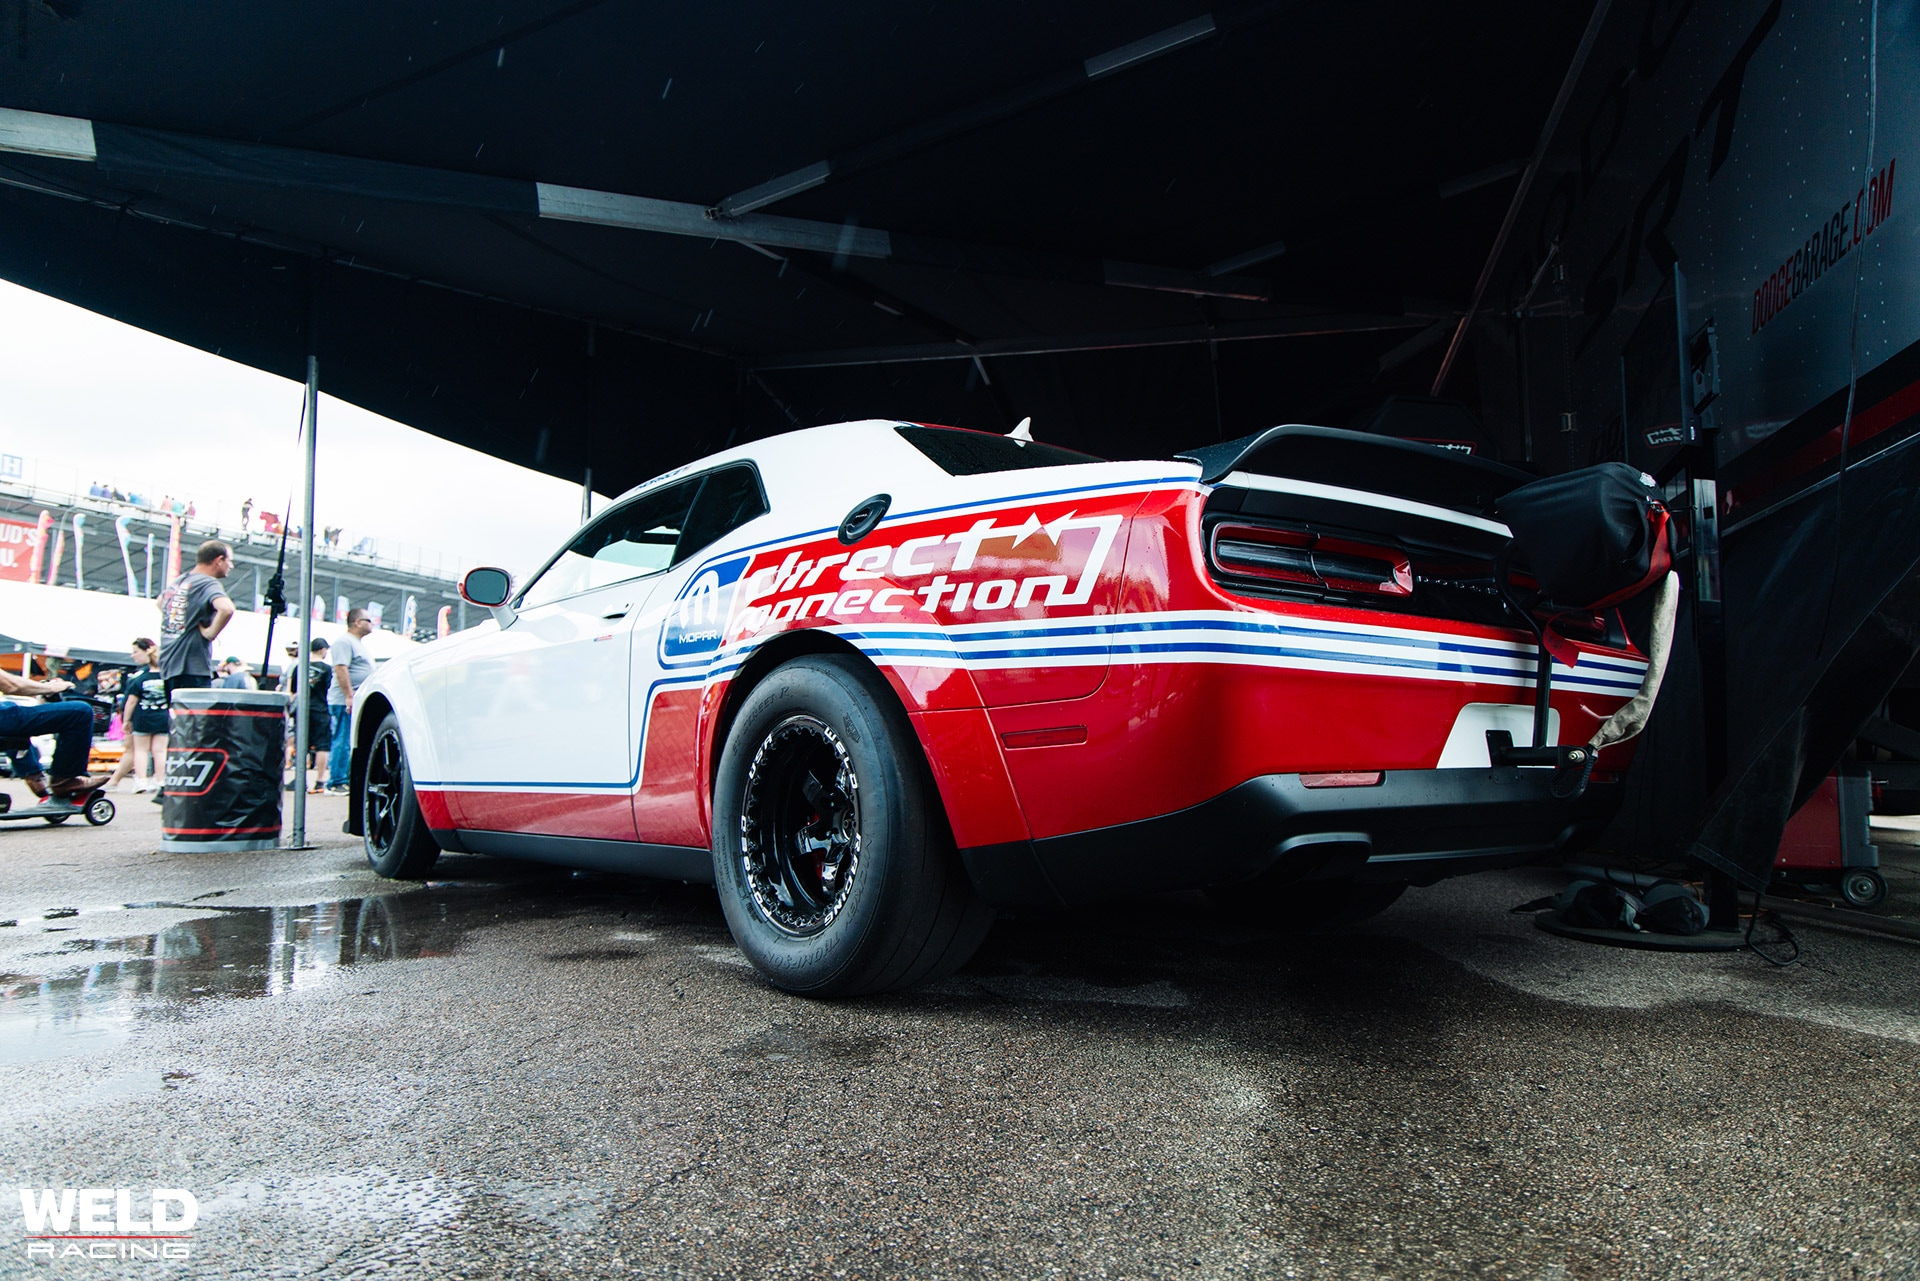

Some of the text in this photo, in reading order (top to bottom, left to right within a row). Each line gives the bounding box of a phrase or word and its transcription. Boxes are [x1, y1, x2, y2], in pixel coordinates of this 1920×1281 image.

[1752, 158, 1896, 335] DODGEGARAGE.COM
[744, 517, 1030, 601] direct
[678, 629, 719, 645] MOPAR
[823, 725, 859, 790] WELD
